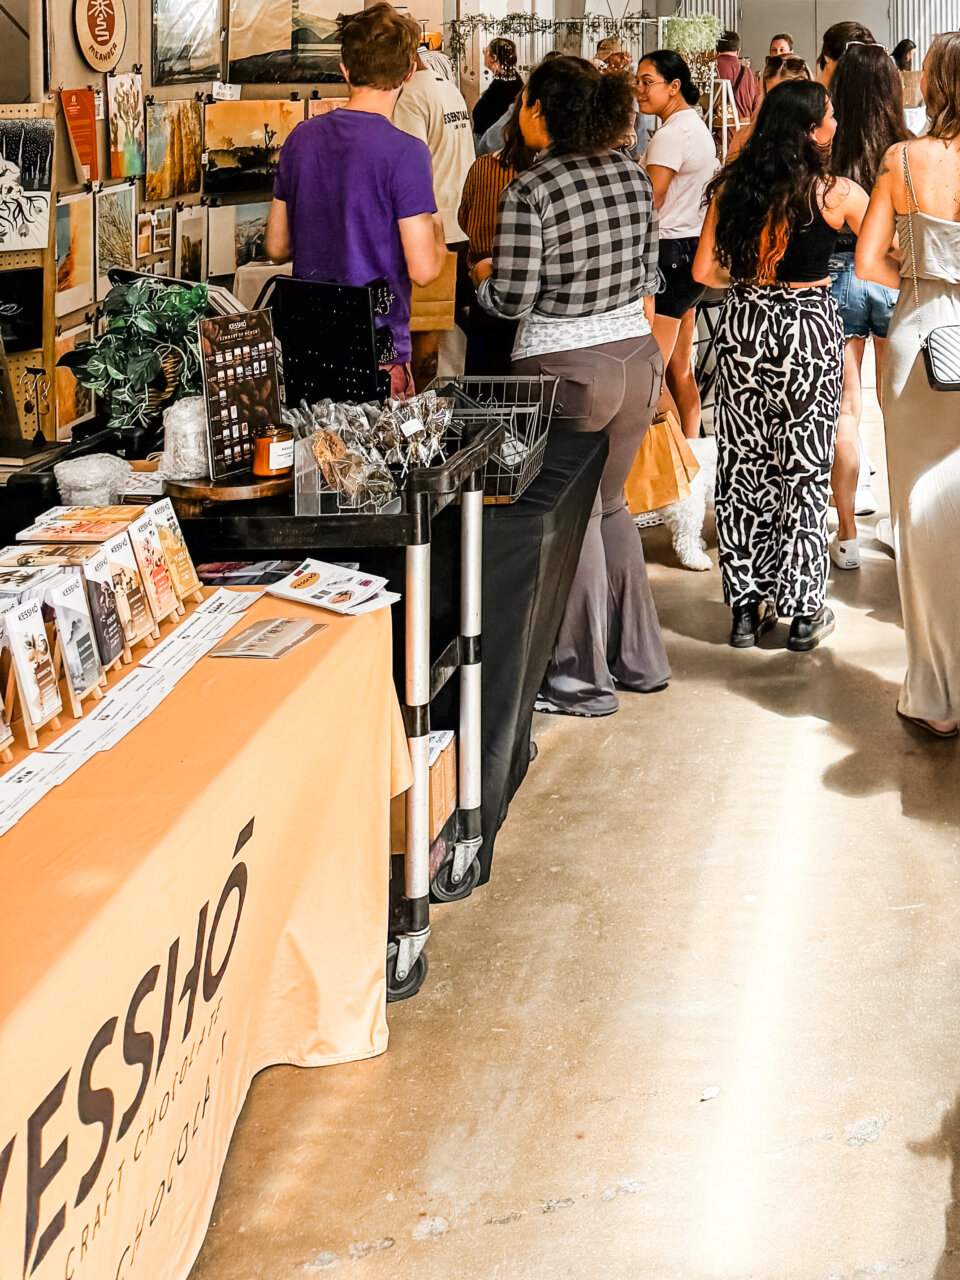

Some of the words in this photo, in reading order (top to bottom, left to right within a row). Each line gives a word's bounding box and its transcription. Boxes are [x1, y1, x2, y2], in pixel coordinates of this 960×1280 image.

[89, 42, 117, 62] MEANDER
[0, 815, 256, 1280] ESSHÓ
[64, 1157, 126, 1280] CRAFT
